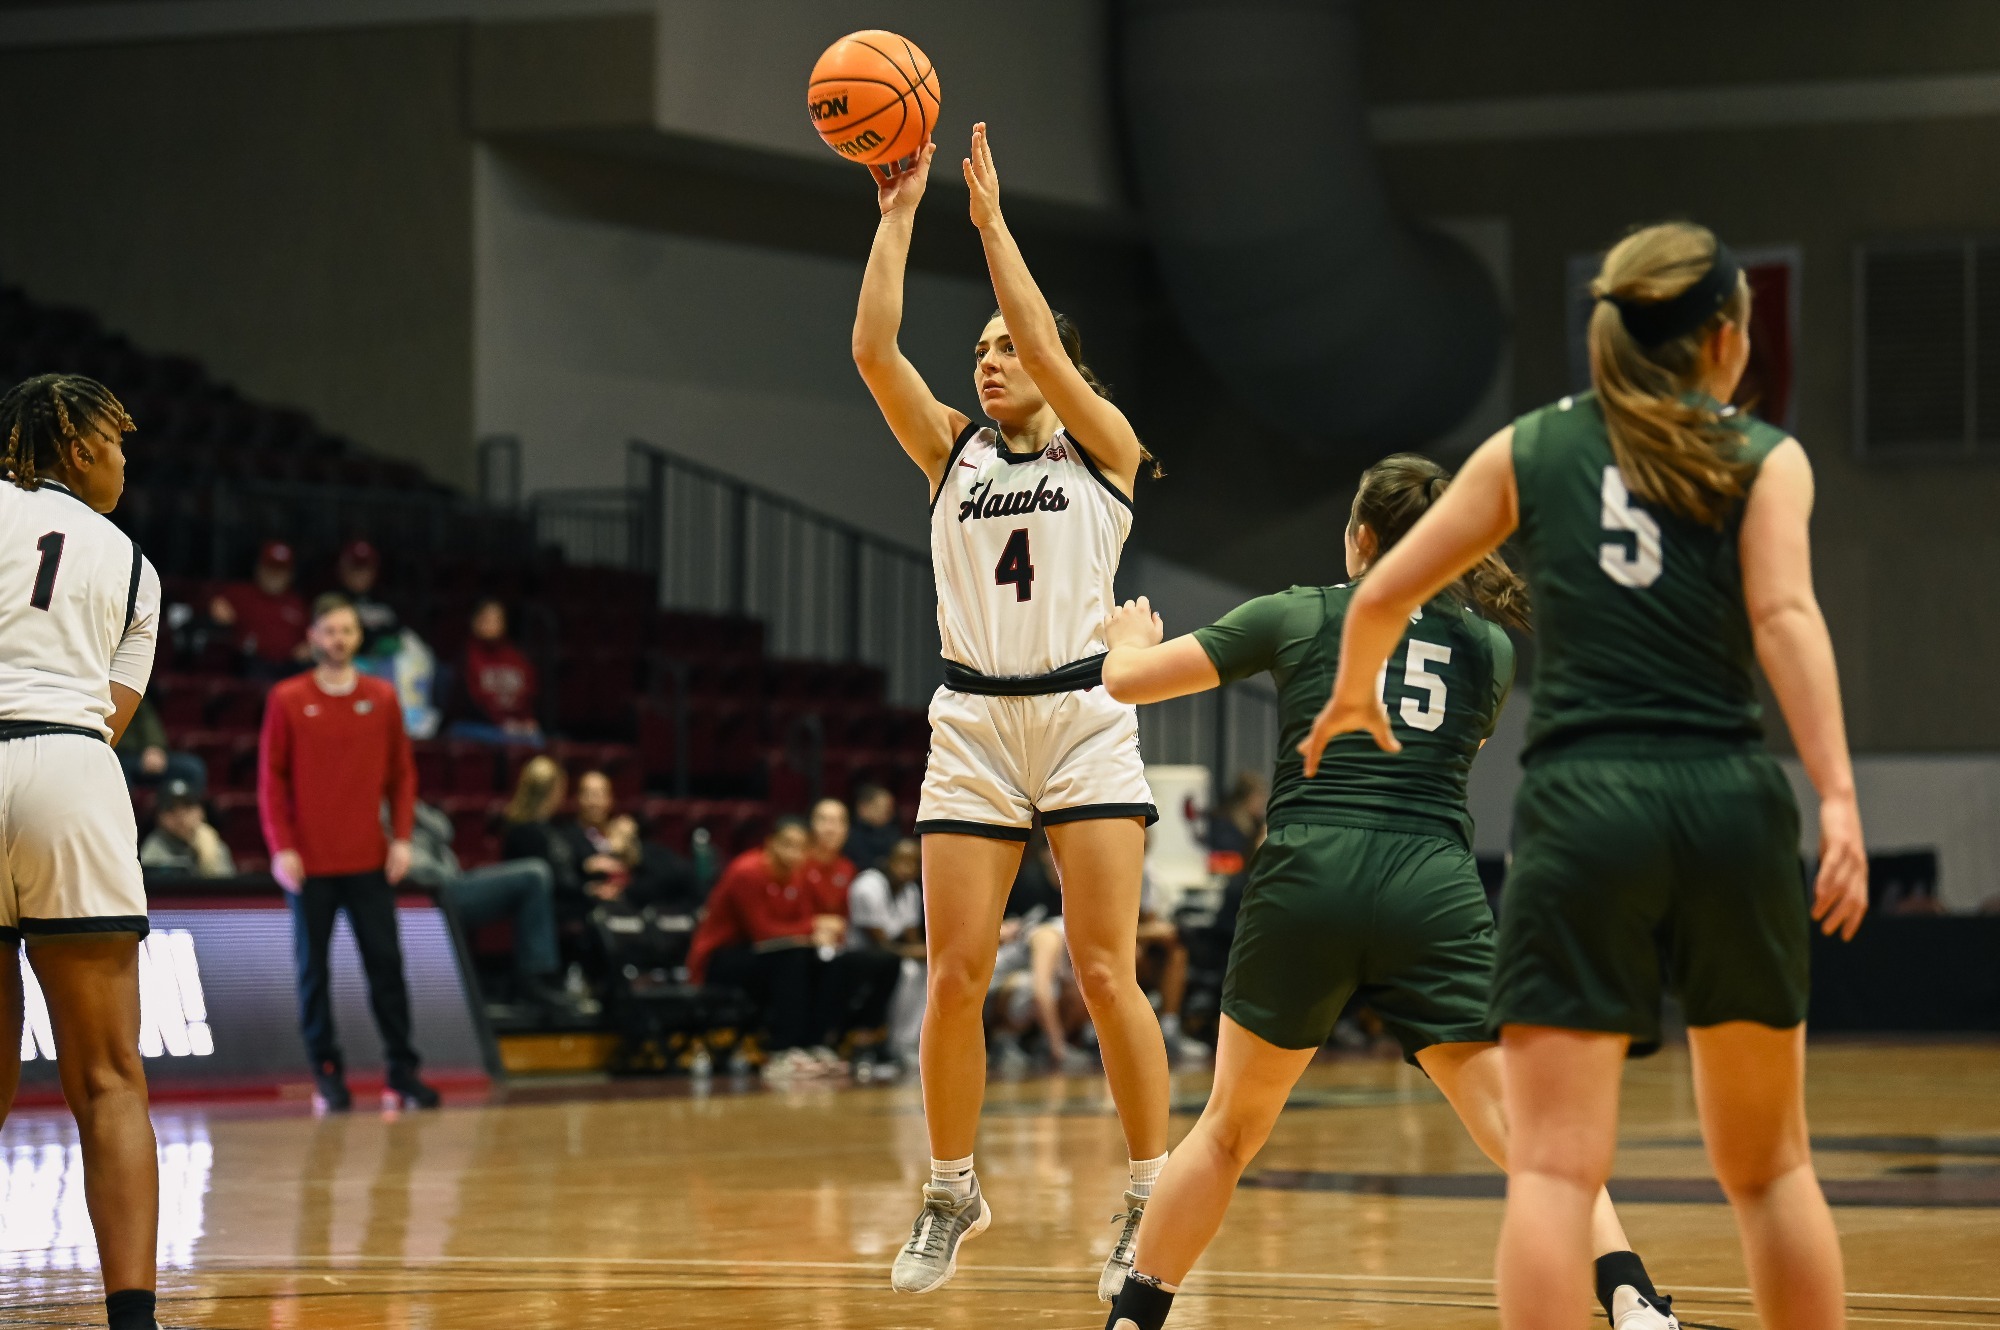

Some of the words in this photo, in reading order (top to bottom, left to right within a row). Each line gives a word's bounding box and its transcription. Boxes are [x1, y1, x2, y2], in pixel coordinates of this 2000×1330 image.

[958, 475, 1069, 523] Hawks
[1599, 465, 1663, 588] 5
[30, 531, 65, 611] 1
[995, 528, 1034, 602] 4
